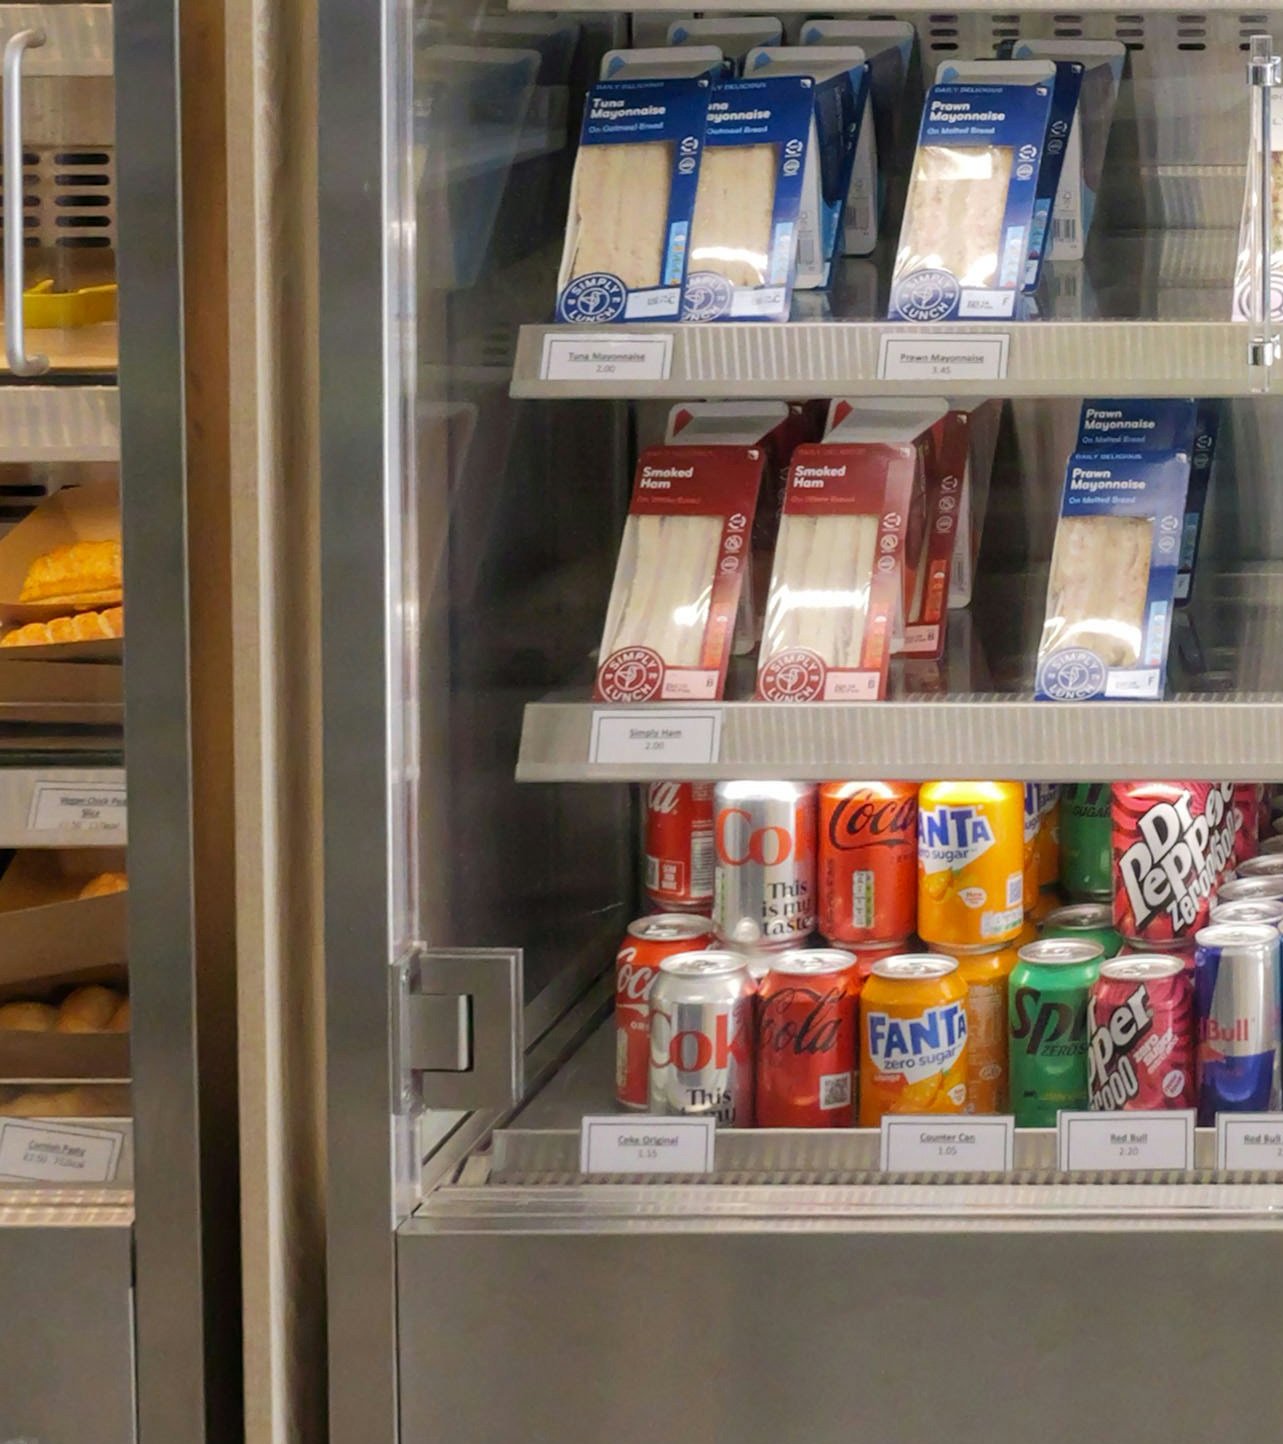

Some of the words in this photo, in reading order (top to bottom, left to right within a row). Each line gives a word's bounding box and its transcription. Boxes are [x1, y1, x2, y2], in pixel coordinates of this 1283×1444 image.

[593, 98, 625, 108] Tuna
[931, 101, 970, 111] Prawn
[590, 106, 666, 120] Mayonnaise
[929, 111, 1006, 124] Mayonnaise
[571, 278, 620, 296] SIMPLY
[568, 307, 616, 323] LUNCH
[642, 466, 694, 478] Smoked
[640, 477, 671, 489] Ham
[767, 881, 808, 899] This
[870, 1006, 967, 1057] FANTA
[1206, 1018, 1250, 1041] Bull
[883, 1054, 916, 1070] zero
[919, 1046, 957, 1066] sugar
[920, 1132, 955, 1144] Counter
[1110, 1133, 1127, 1145] Red
[1129, 1133, 1148, 1145] Bull
